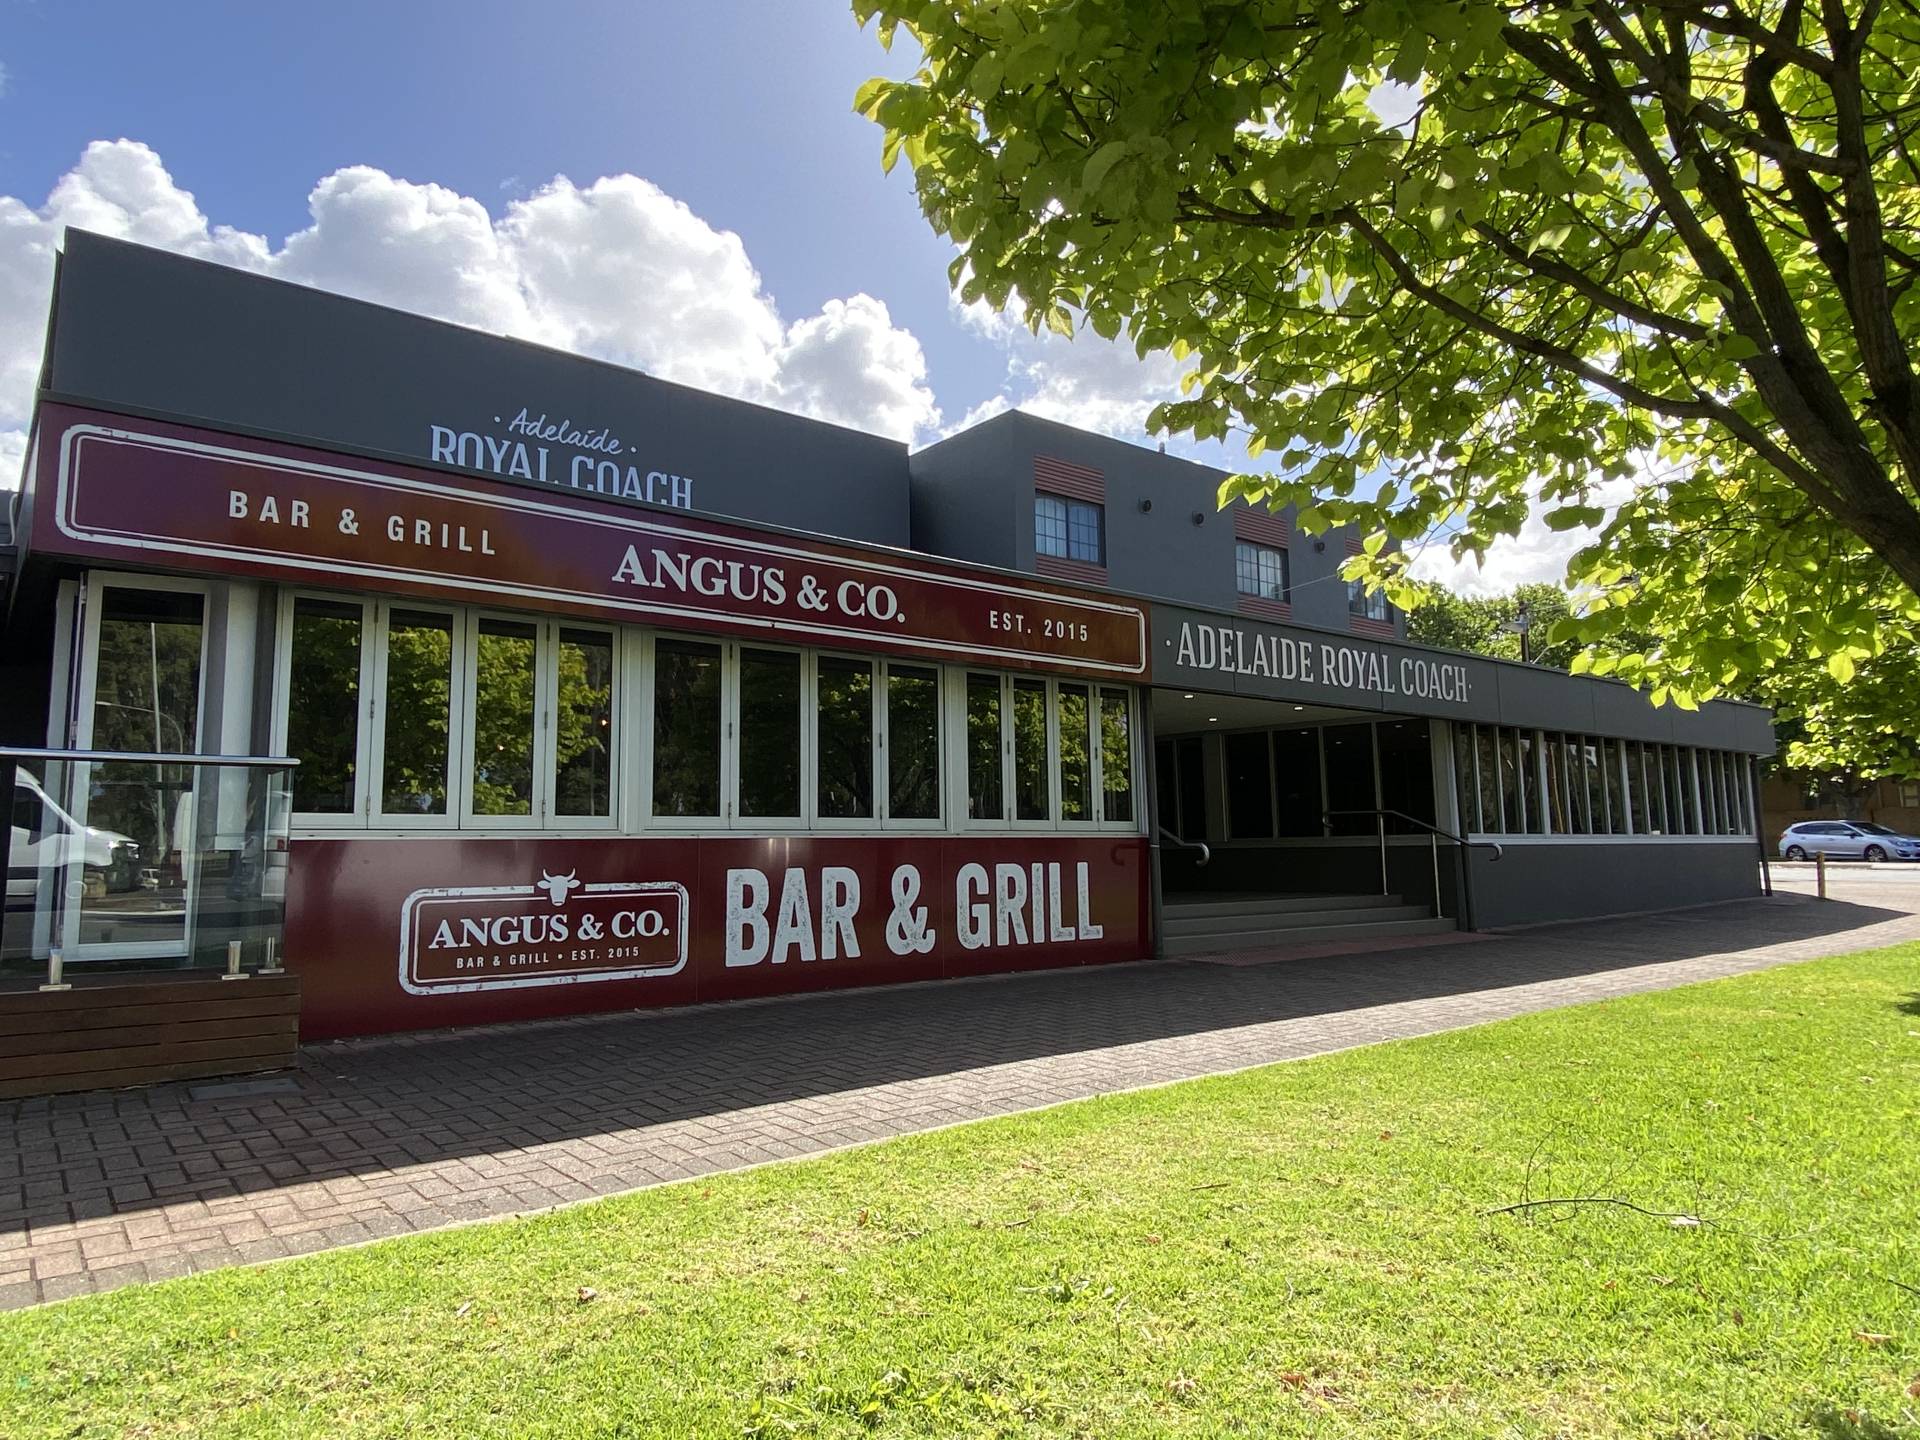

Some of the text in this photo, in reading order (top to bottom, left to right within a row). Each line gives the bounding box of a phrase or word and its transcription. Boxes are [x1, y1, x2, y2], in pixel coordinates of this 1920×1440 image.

[508, 407, 623, 455] Adelaide
[430, 424, 693, 510] ROYAL COACH
[228, 490, 496, 555] BAR & GRILL
[611, 544, 906, 623] ANGUS & CO.
[989, 610, 1088, 641] EST. 2015
[1176, 622, 1469, 703] ADELAIDE ROYAL COACH
[428, 910, 670, 949] ANGUS & CO.
[725, 861, 1104, 967] BAR & GRILL
[456, 946, 640, 969] BAR & GRILL EST. 2015
